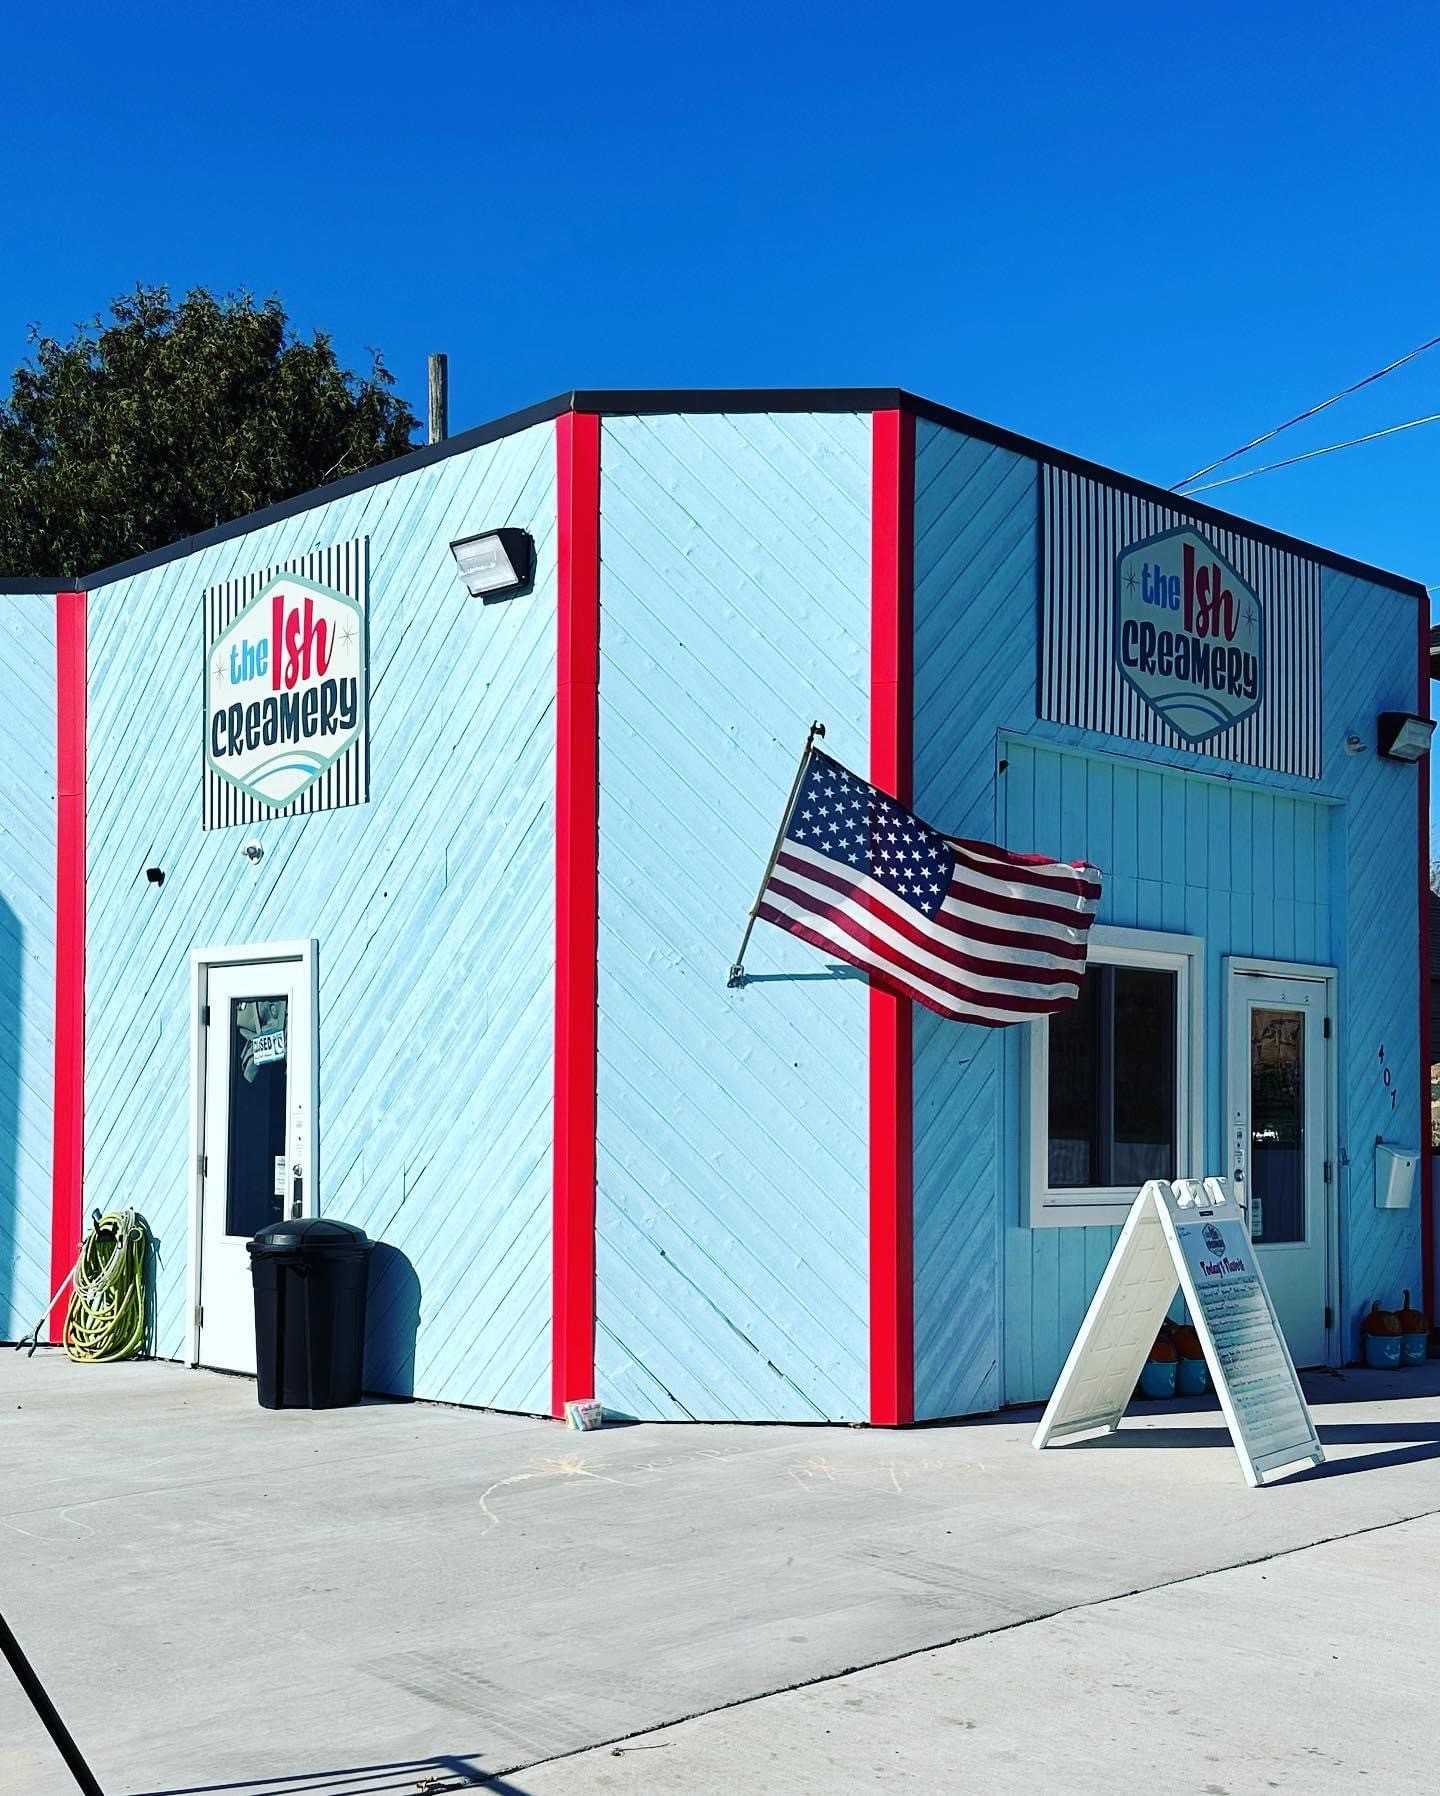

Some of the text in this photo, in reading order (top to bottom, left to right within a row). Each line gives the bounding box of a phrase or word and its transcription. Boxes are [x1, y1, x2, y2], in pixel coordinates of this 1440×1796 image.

[1141, 543, 1241, 642] the Ish
[229, 594, 337, 691] the Ish
